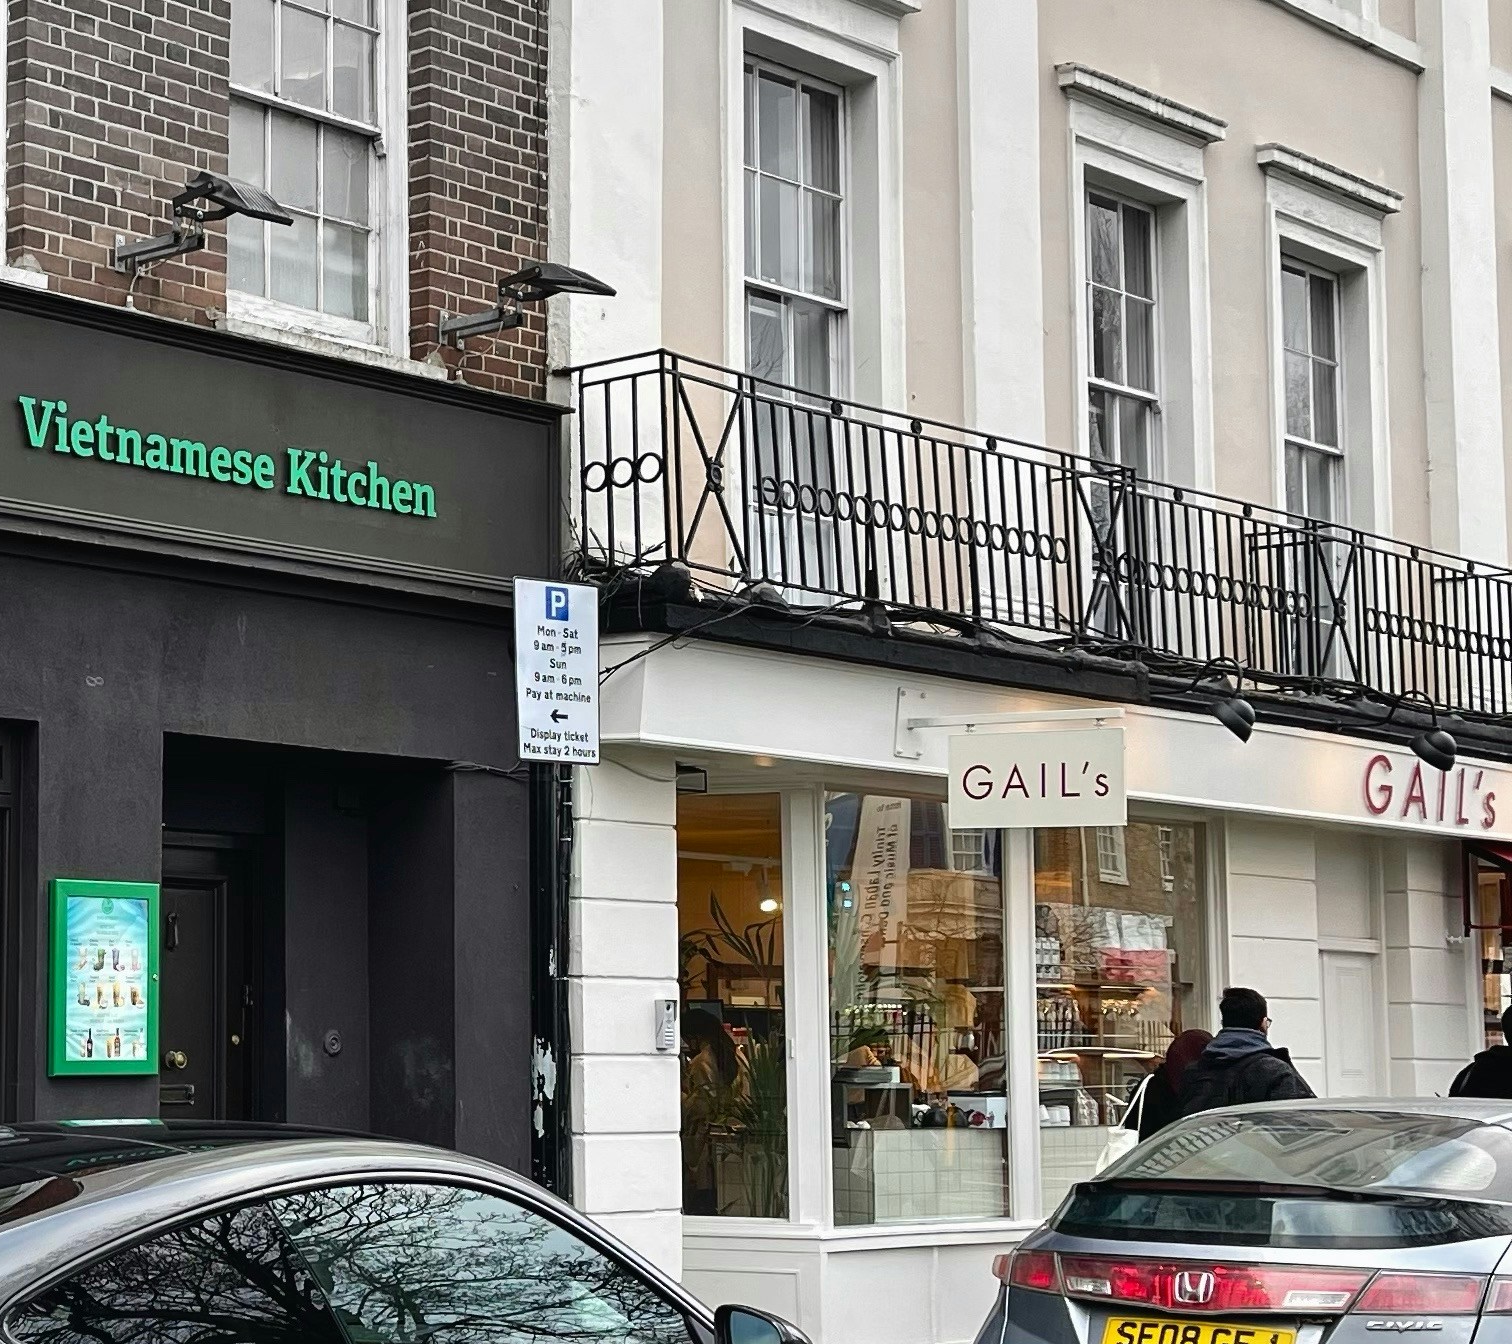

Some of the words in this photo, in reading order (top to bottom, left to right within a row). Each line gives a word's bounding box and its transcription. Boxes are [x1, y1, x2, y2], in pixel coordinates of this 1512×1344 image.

[18, 395, 275, 489] Vietnamese
[286, 447, 437, 518] Kitchen
[550, 590, 566, 617] P
[537, 625, 557, 638] Mon
[563, 627, 578, 640] Sat
[549, 658, 567, 670] Sun
[526, 687, 541, 701] Pay
[544, 689, 553, 700] at
[555, 691, 591, 703] machine
[530, 728, 562, 742] Display
[564, 730, 588, 743] ticket
[523, 743, 542, 755] Max
[544, 744, 562, 757] stay
[564, 746, 569, 756] 2
[572, 745, 596, 758] hours
[963, 761, 1109, 800] GAIL's
[1362, 755, 1496, 828] GAIL's
[1365, 1319, 1443, 1332] CIVIC
